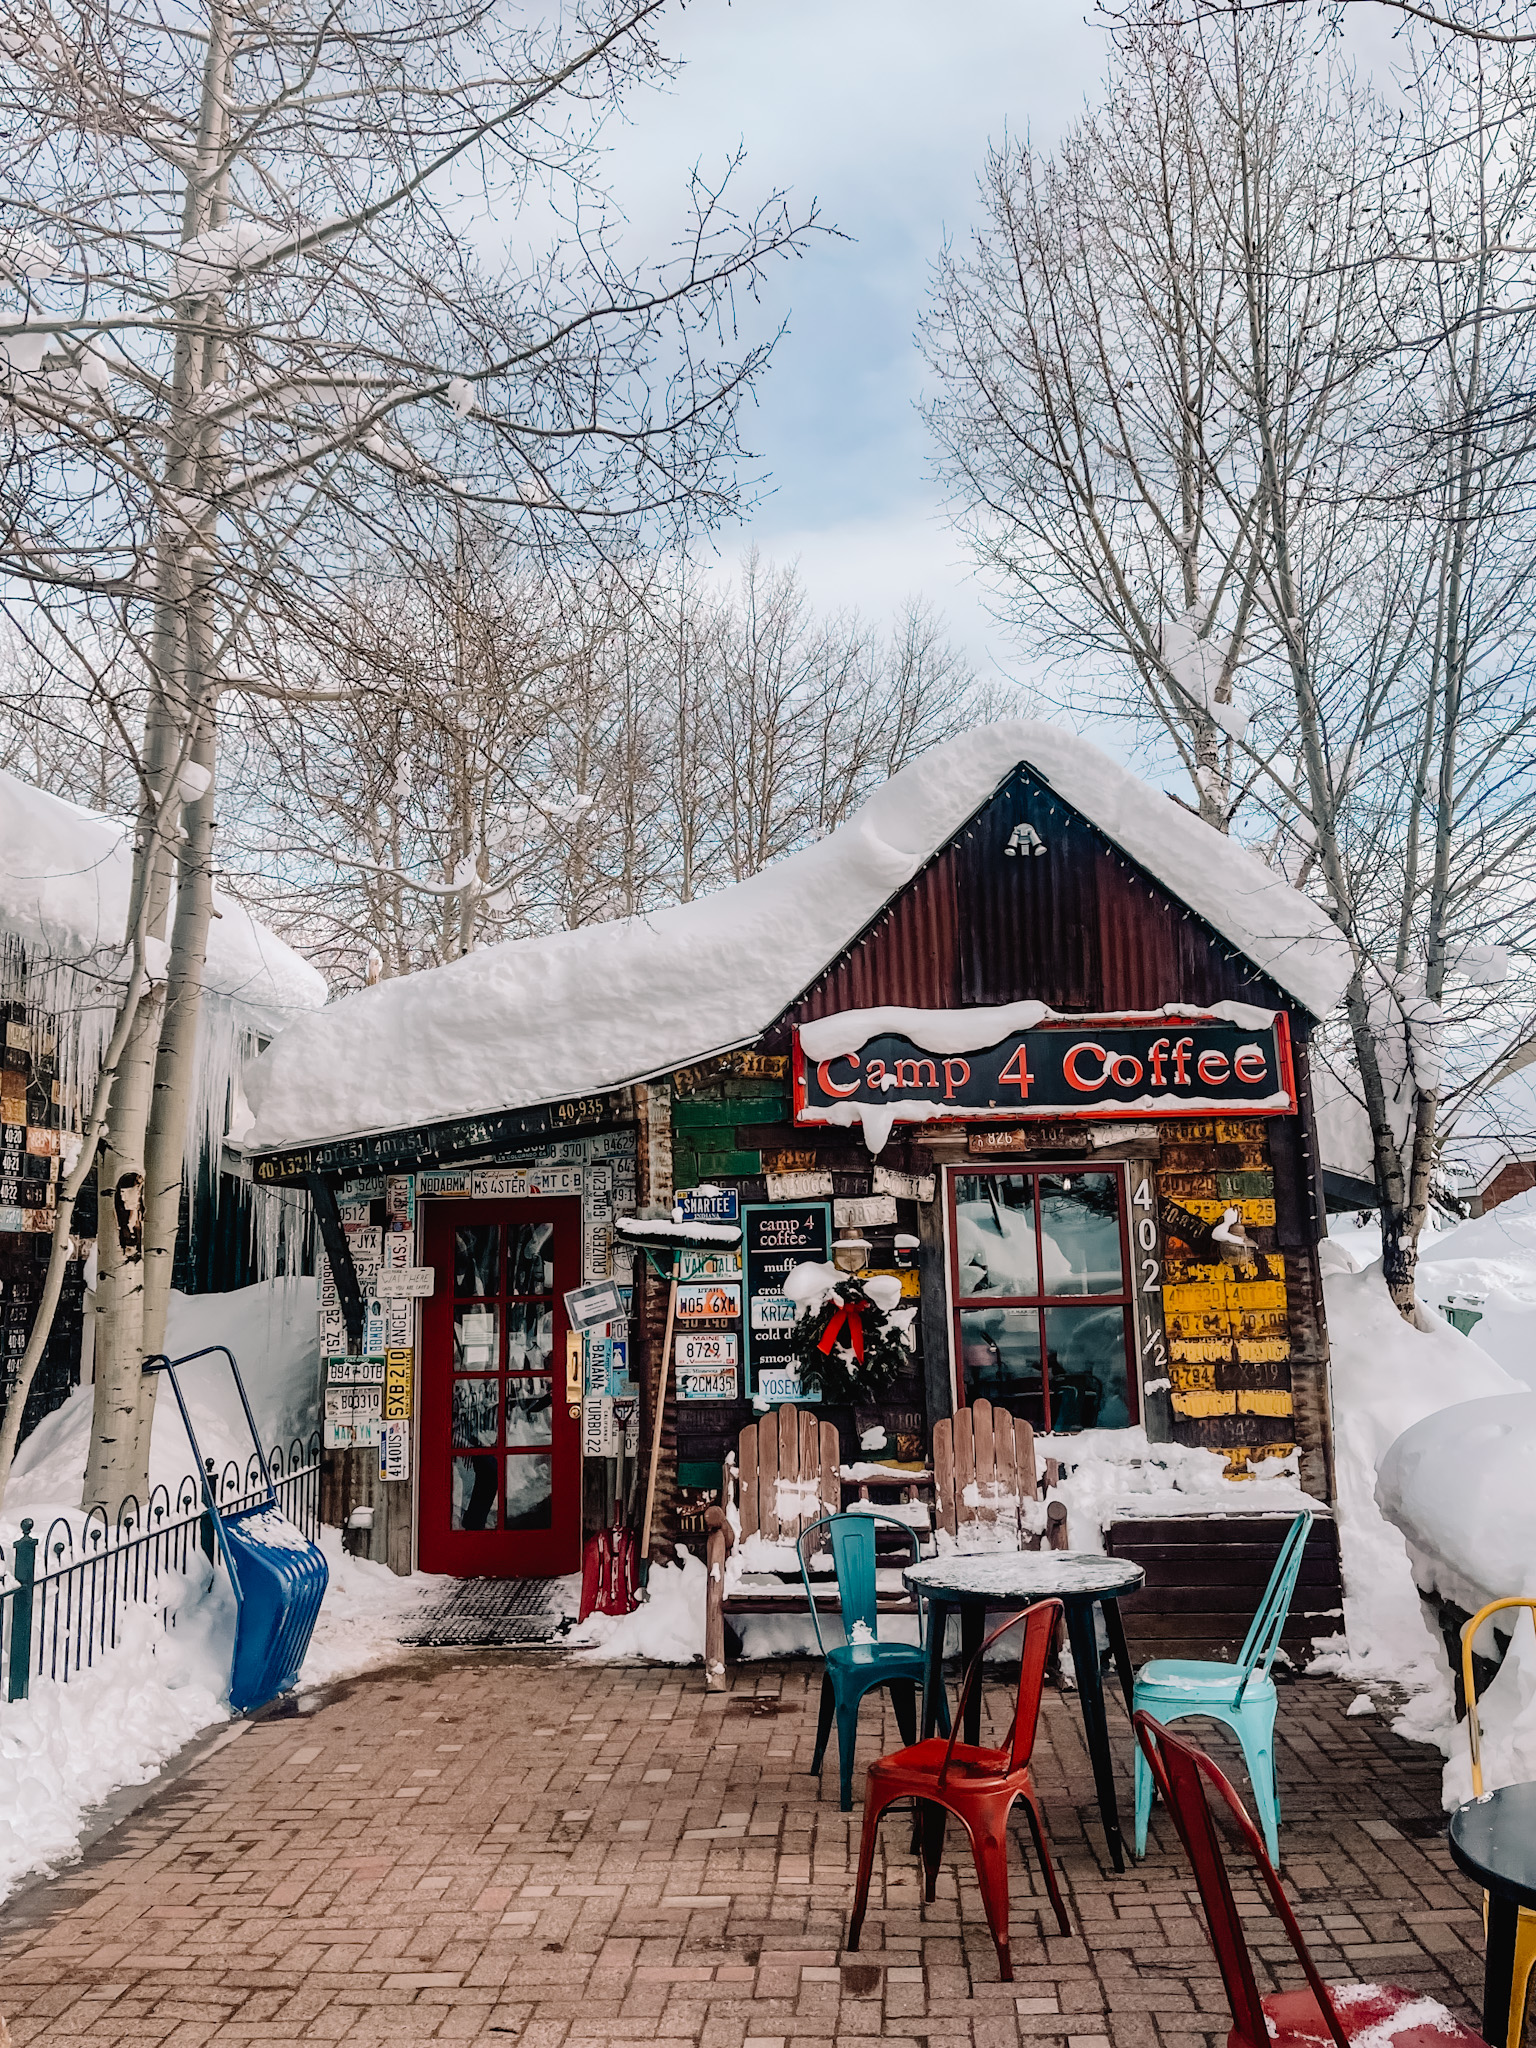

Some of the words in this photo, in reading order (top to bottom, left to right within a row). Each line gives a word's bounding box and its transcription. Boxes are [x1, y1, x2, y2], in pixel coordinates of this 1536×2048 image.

[817, 1053, 971, 1099] Camp
[998, 1043, 1035, 1098] 4
[1063, 1036, 1268, 1092] Coffee
[474, 1181, 488, 1195] MS
[592, 1170, 607, 1219] GRACE2U
[683, 1197, 731, 1214] SHARTEE
[759, 1219, 800, 1235] camp
[803, 1214, 815, 1230] 4
[760, 1230, 807, 1247] coffee
[592, 1226, 608, 1275] CRUZERS
[381, 1274, 408, 1284] WAIT
[409, 1273, 430, 1283] HERE
[391, 1303, 407, 1346] ANGEL
[755, 1327, 781, 1341] cold
[686, 1342, 720, 1359] 8729
[725, 1342, 733, 1358] T
[591, 1344, 606, 1391] BANANA
[388, 1351, 406, 1417] SXB-210
[692, 1376, 733, 1393] 2CM435
[587, 1399, 602, 1436] TURBO
[587, 1439, 602, 1454] 22
